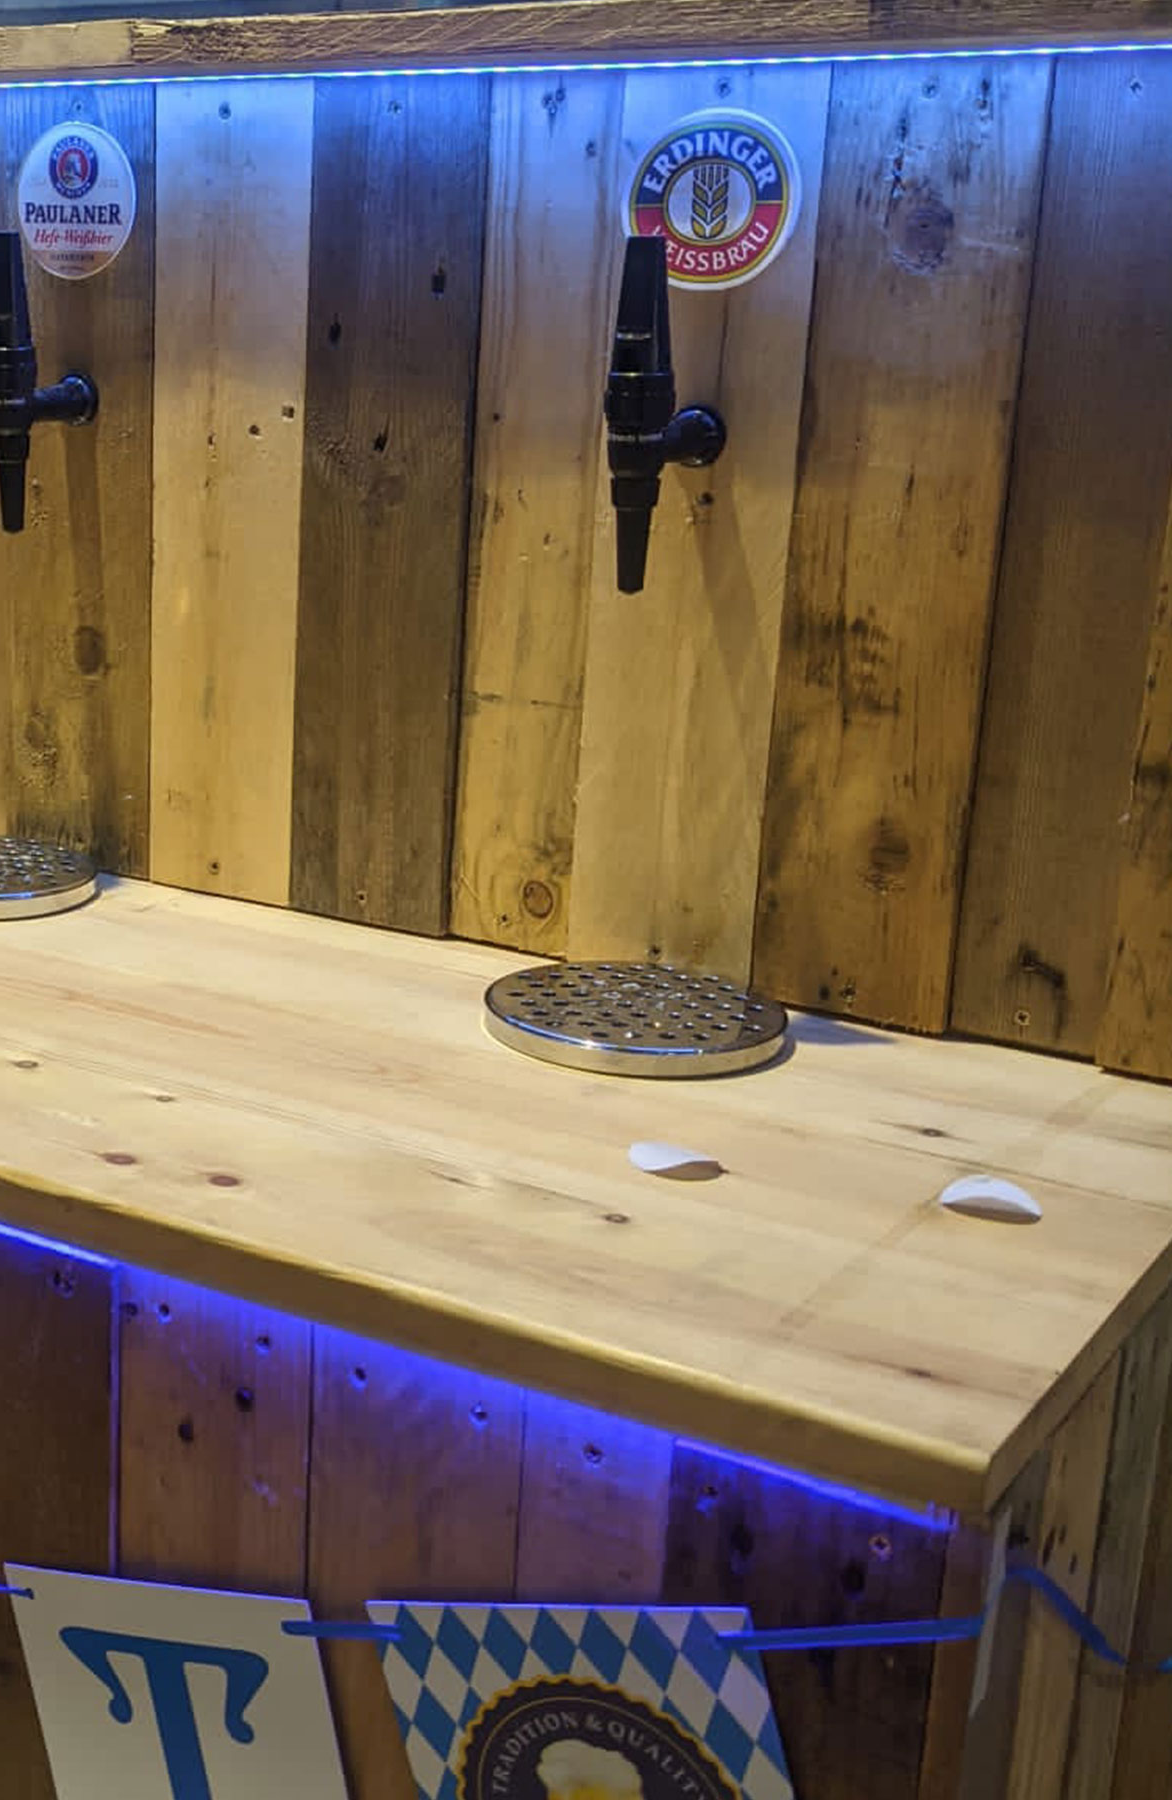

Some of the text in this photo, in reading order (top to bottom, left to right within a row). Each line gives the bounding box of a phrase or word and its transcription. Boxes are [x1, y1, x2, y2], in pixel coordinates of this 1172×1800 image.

[643, 131, 777, 193] ERDINGER
[24, 202, 121, 225] PAULANER
[650, 221, 769, 272] EISSBRÄU
[492, 1711, 706, 1800] TRADITION & QUALIT
